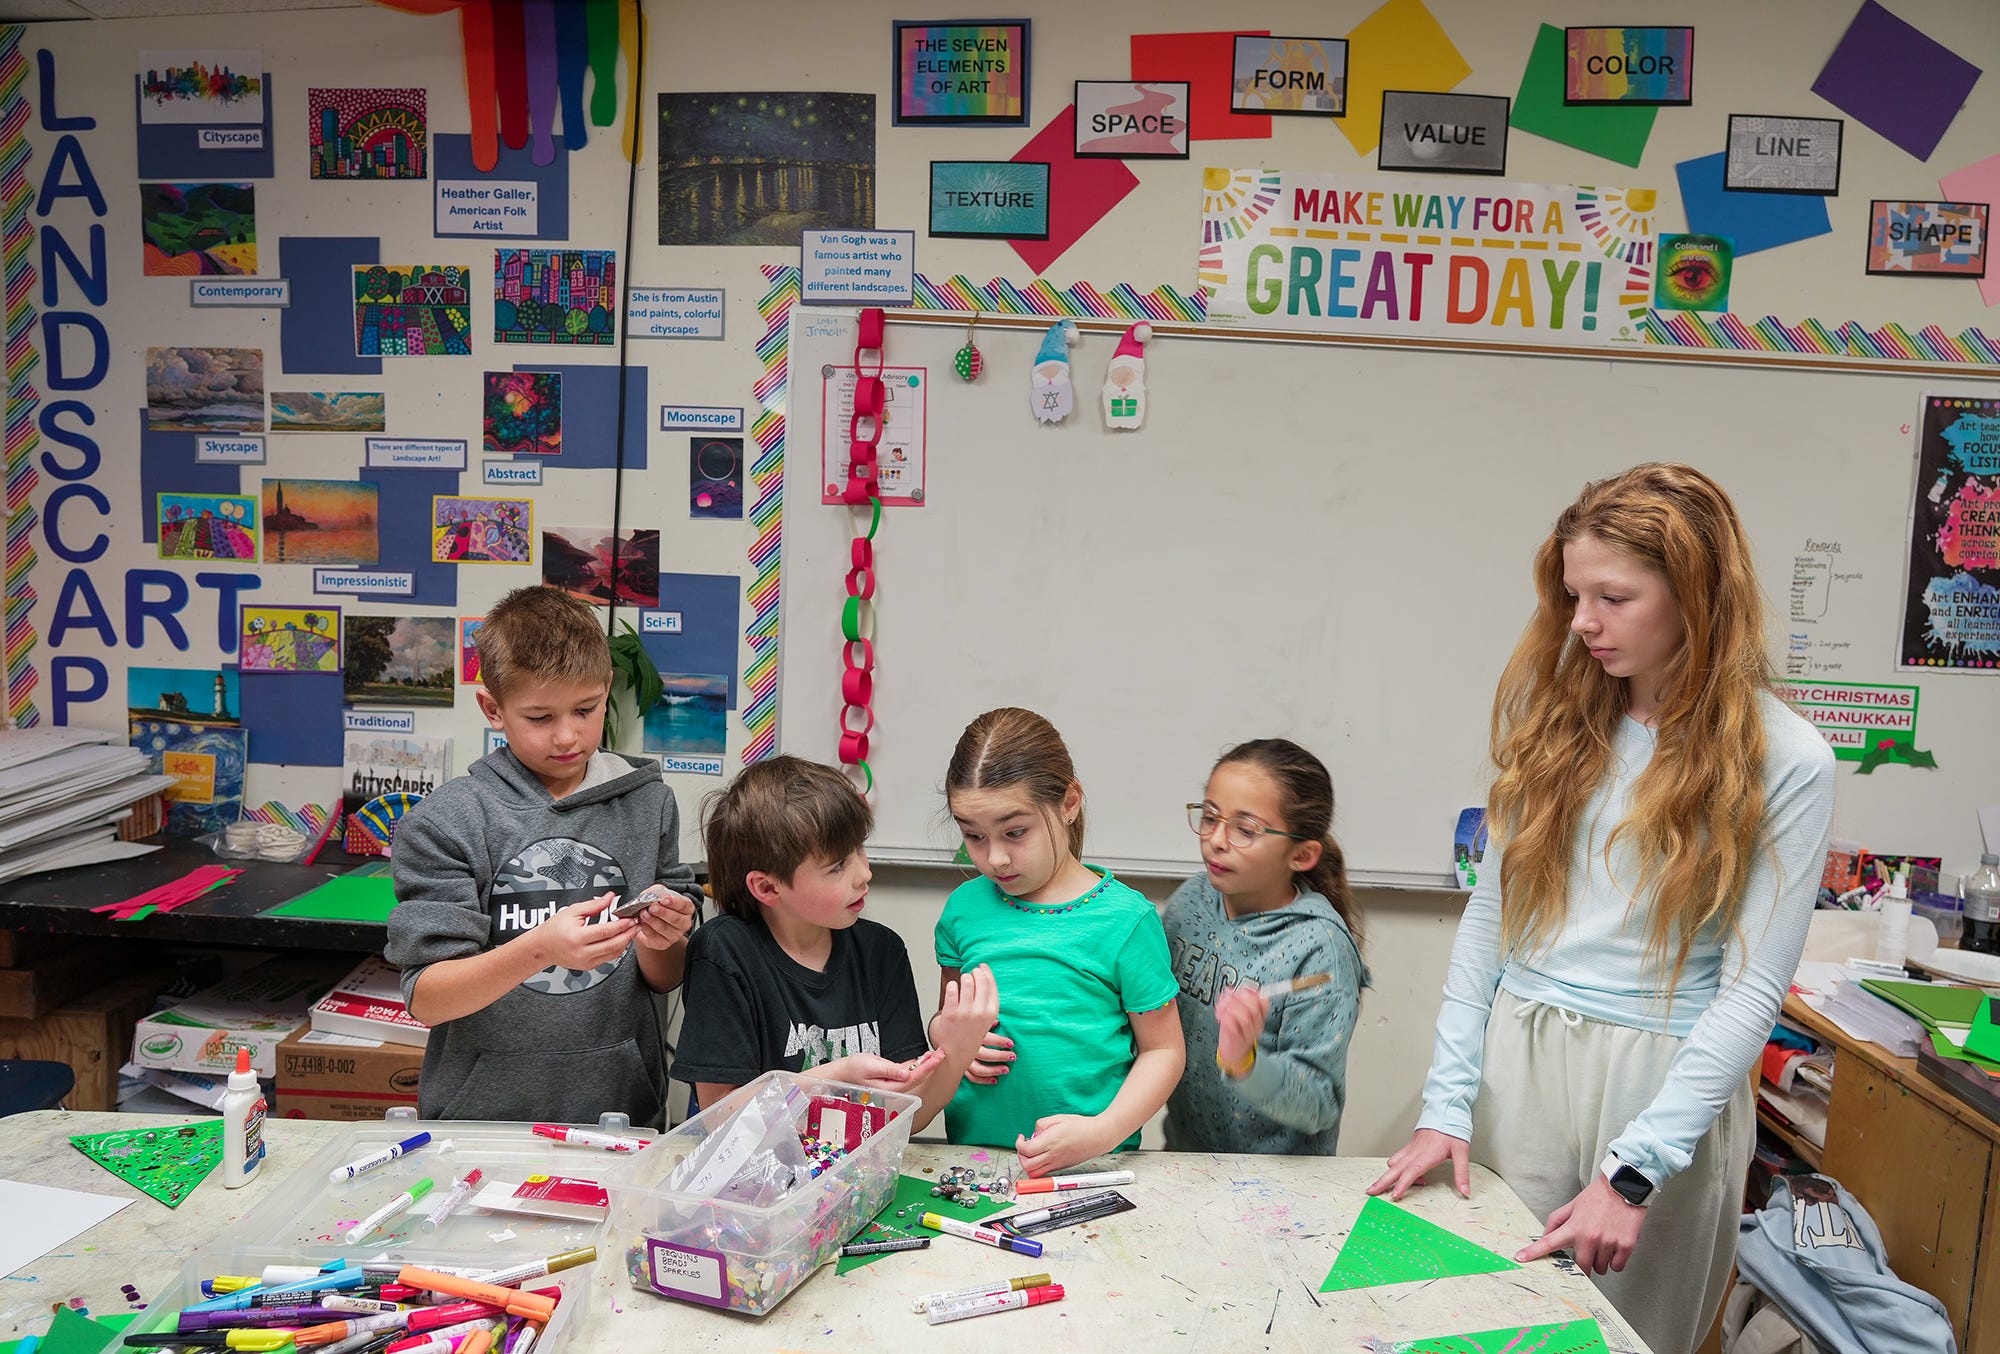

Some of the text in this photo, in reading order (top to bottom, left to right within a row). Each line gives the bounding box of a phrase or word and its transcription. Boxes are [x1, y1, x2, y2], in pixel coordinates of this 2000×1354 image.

[915, 38, 1007, 52] THE SEVEN
[917, 59, 1005, 74] ELEMENTS
[1586, 55, 1674, 75] COLOR
[1254, 69, 1325, 91] FORM
[931, 80, 990, 94] OF ART
[1092, 114, 1174, 134] SPACE
[203, 130, 260, 145] Cityscape
[1404, 122, 1486, 146] VALUE
[1755, 136, 1811, 158] LINE
[441, 187, 535, 203] Heather Galler,
[945, 191, 1035, 208] TEXTURE
[449, 205, 527, 217] American Folk
[1293, 187, 1564, 235] MAKE WAY FOR A
[473, 219, 503, 231] Artist
[1889, 221, 1972, 244] SHAPE
[820, 235, 839, 244] Van
[842, 235, 867, 246] Gogh
[869, 237, 888, 245] was
[1674, 242, 1697, 250] Color
[814, 250, 902, 261] famous artist who
[824, 266, 892, 279] painted many
[198, 284, 283, 300] Contemporary
[807, 282, 908, 294] different landscapes.
[1245, 244, 1602, 332] GREAT DAY!
[632, 292, 718, 304] She is from Austin
[629, 309, 721, 320] and paints, colorful
[650, 324, 699, 336] cityscapes
[882, 373, 908, 381] Advisory
[667, 411, 736, 424] Moonscape
[1959, 421, 1976, 430] Art
[1980, 432, 2000, 441] how
[205, 440, 258, 455] Skyscape
[434, 445, 453, 453] types
[392, 455, 427, 463] Landscape
[1970, 456, 2000, 468] LIST
[487, 468, 537, 479] Abstract
[1960, 499, 1979, 509] Art
[1804, 538, 1842, 552] Rewards
[1961, 539, 1997, 548] across
[321, 575, 407, 590] Impressionistic
[1931, 592, 1949, 603] Art
[1931, 606, 1951, 617] and
[646, 616, 676, 628] Sci-Fi
[1947, 619, 1960, 629] all
[1811, 689, 1910, 705] CHRISTMAS
[347, 715, 411, 728] Traditional
[1813, 710, 1910, 726] HANUKKAH
[1830, 732, 1862, 743] ALL!
[667, 758, 720, 773] Seascape
[352, 768, 434, 796] CITYSCAPES
[320, 1003, 339, 1012] 144
[366, 1005, 398, 1016] PACK
[288, 1056, 355, 1074] 57-4418-0-002
[661, 1249, 699, 1263] SEQUINS
[662, 1256, 687, 1267] BEADS
[663, 1266, 701, 1279] SPARKLES
